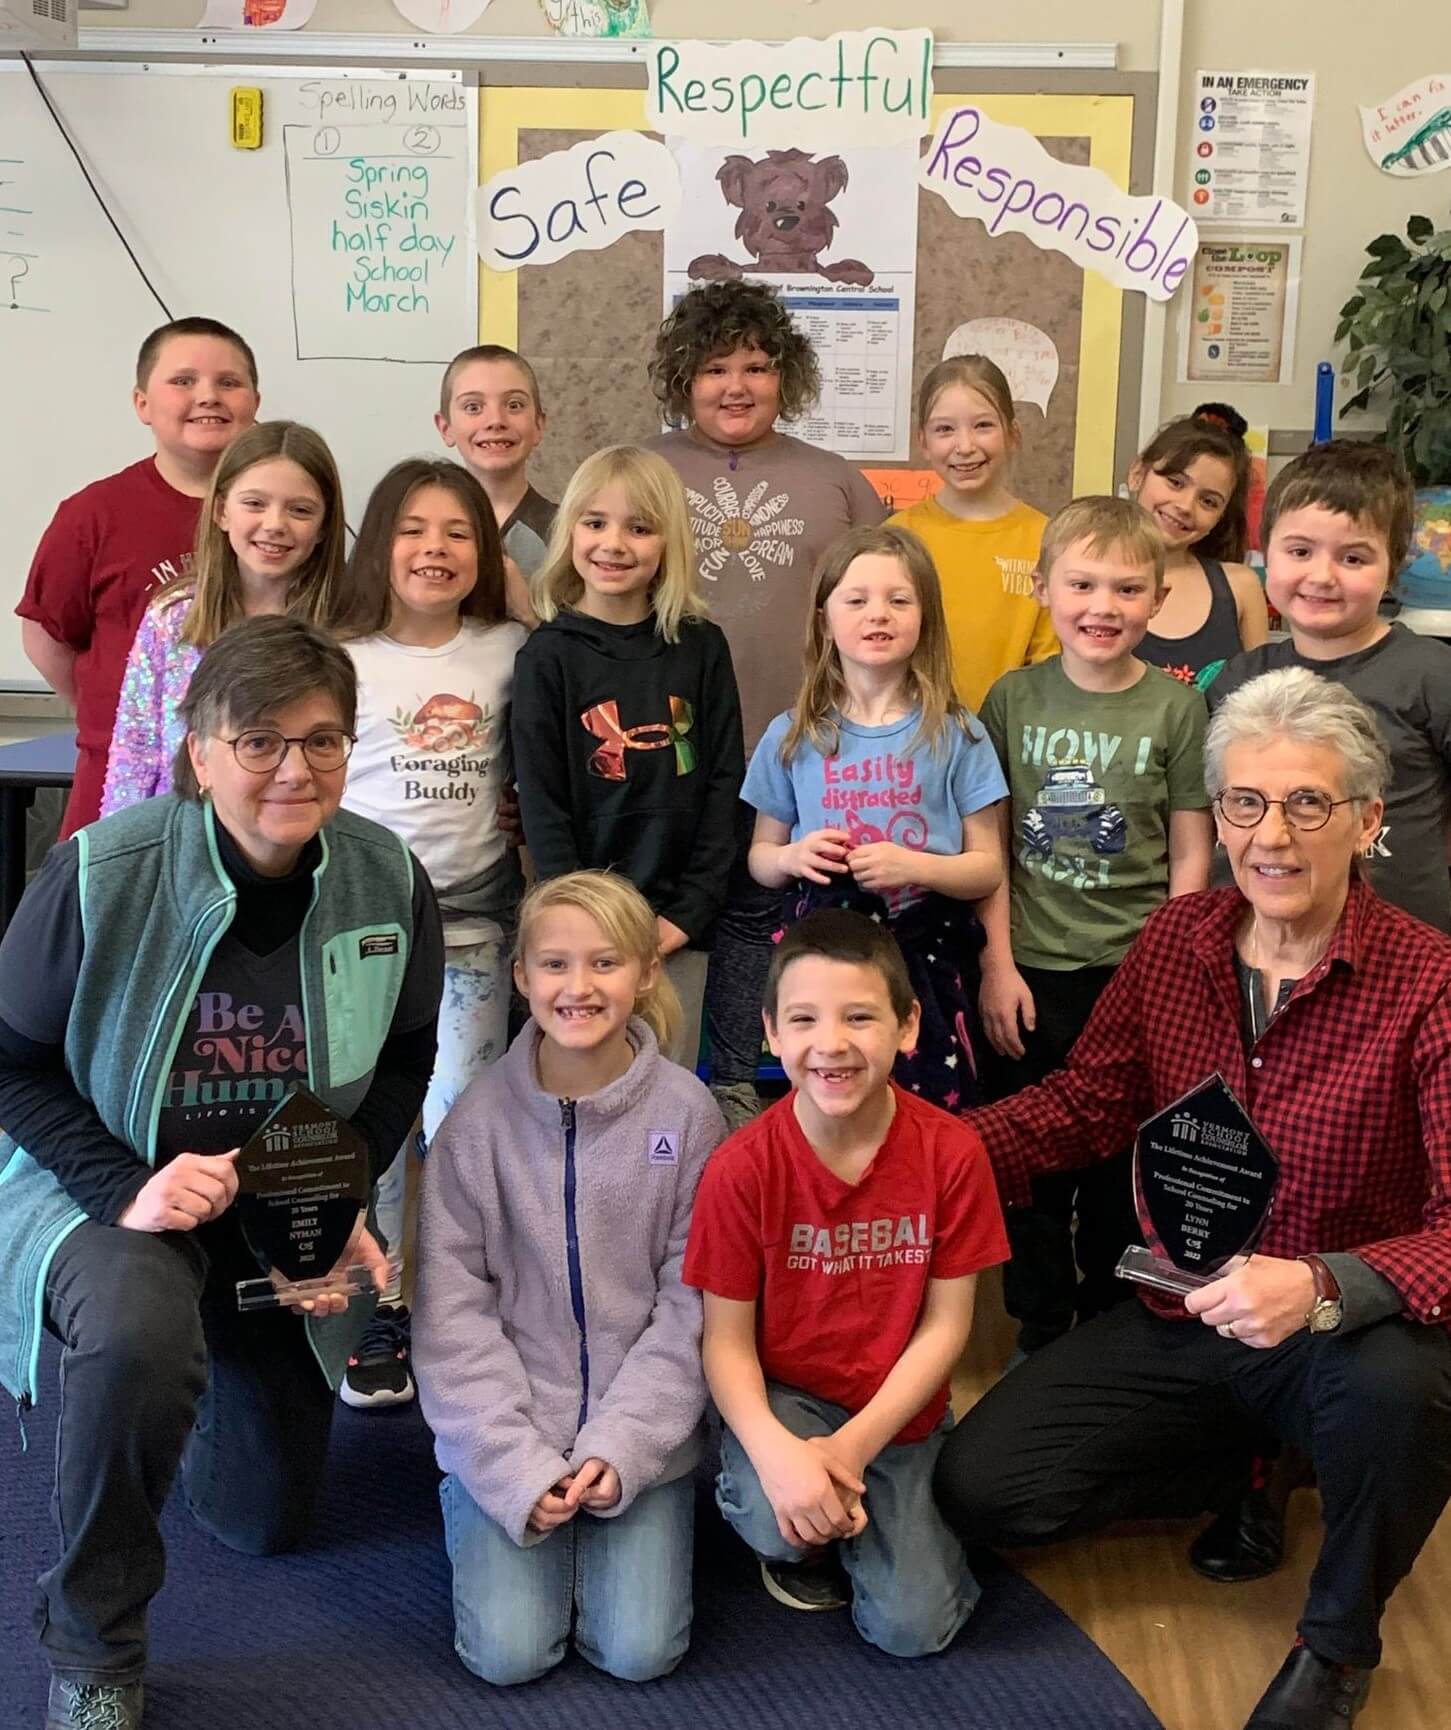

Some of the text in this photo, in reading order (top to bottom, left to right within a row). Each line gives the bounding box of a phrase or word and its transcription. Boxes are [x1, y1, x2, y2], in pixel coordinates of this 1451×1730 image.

[657, 36, 931, 137] Respectful
[1202, 76, 1309, 91] IN AN EMERGENCY
[1228, 88, 1281, 97] TAKE ACTION
[299, 82, 466, 123] Spelling Words
[346, 157, 429, 197] Spring
[345, 195, 429, 219] Siskin
[490, 151, 661, 260] Safe
[927, 108, 1189, 294] Responsible
[332, 220, 455, 267] half day
[353, 256, 429, 284] School
[346, 283, 429, 314] March
[836, 285, 865, 293] Central
[868, 285, 894, 293] School
[754, 519, 805, 537] HAPPINESS
[699, 547, 730, 581] FUN
[738, 550, 766, 581] LOVE
[749, 540, 794, 567] DREAM
[1022, 725, 1151, 775] HOW I
[390, 754, 490, 778] Foraging
[824, 752, 914, 788] Easily
[405, 780, 479, 806] Buddy
[822, 784, 922, 810] distracted
[1366, 826, 1392, 858] K
[196, 992, 264, 1033] Be
[162, 1070, 285, 1108] Hum
[790, 1214, 930, 1258] BASEBAL
[787, 1255, 817, 1271] GOT
[822, 1256, 856, 1275] WHAT
[858, 1255, 875, 1270] IT
